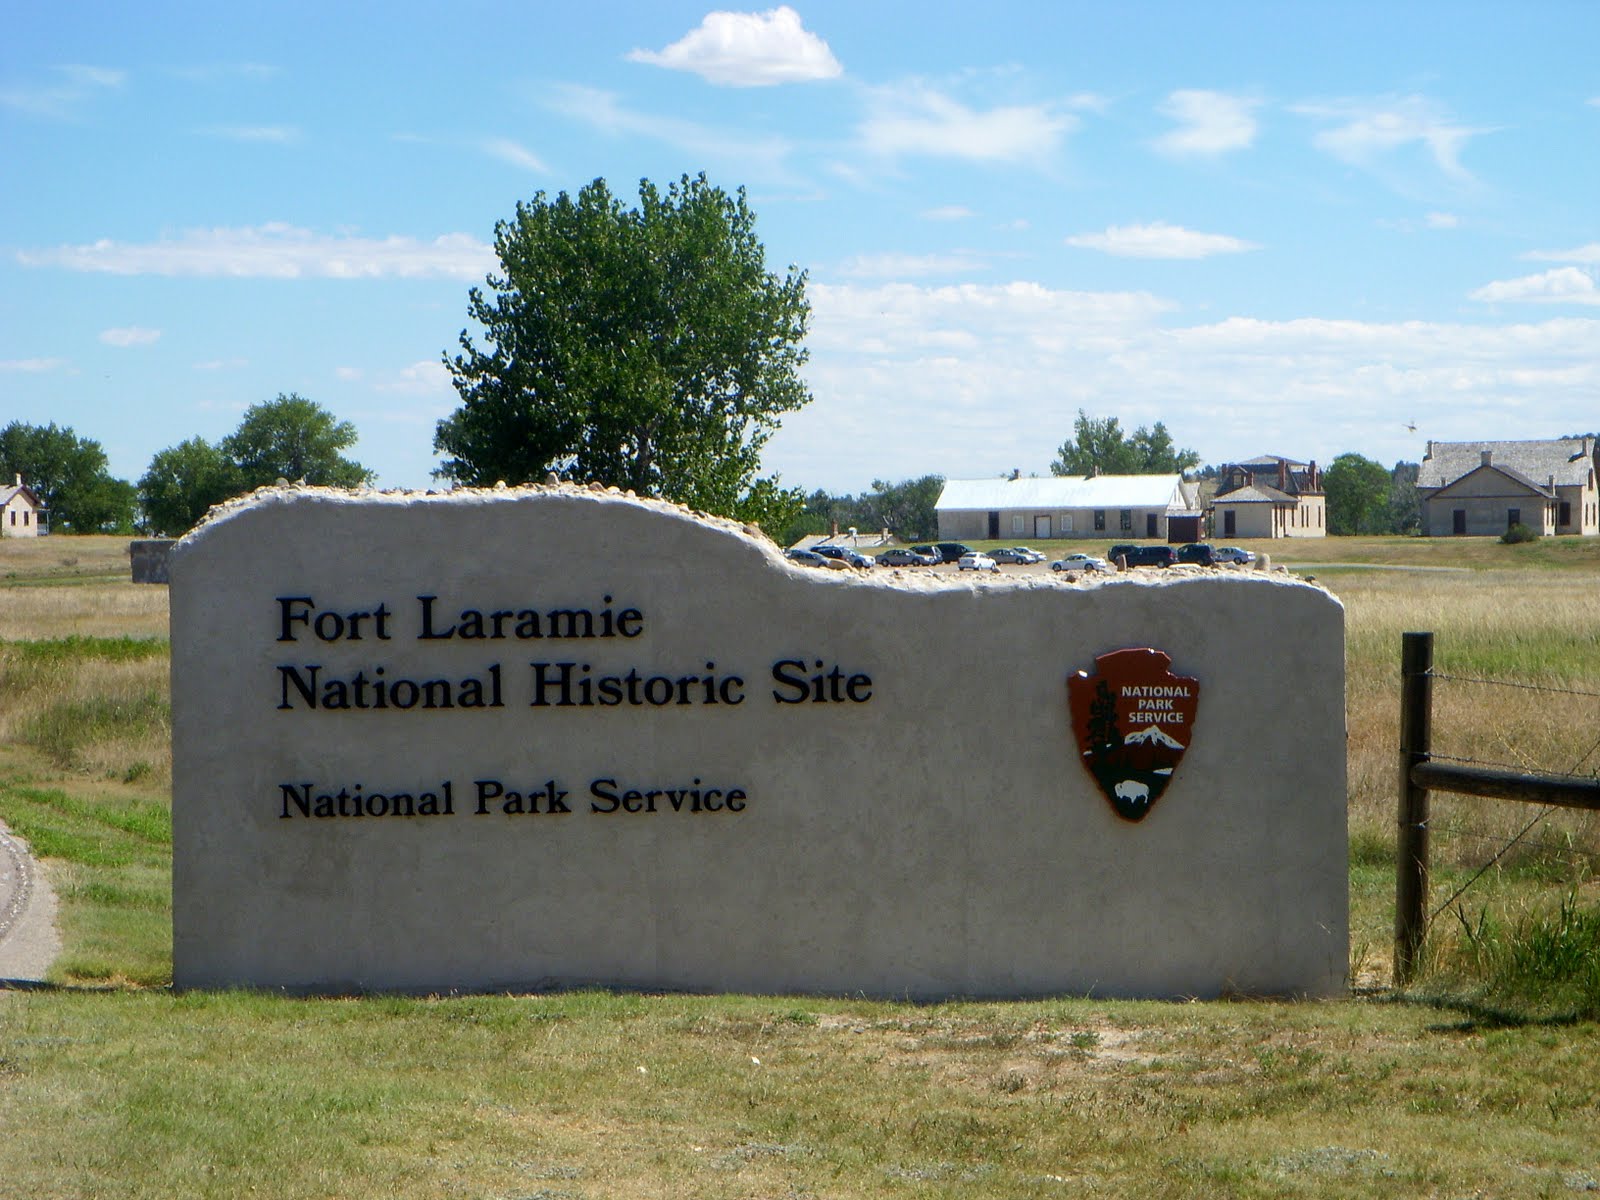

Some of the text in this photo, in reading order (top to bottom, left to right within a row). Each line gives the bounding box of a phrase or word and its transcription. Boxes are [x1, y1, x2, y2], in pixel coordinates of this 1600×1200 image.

[275, 594, 644, 644] Fort Laramie
[276, 658, 873, 712] National Historic Site
[1122, 686, 1191, 697] NATIONAL
[1128, 712, 1184, 723] SERVICE
[1138, 699, 1174, 710] PARK
[277, 777, 747, 820] National Park Service
